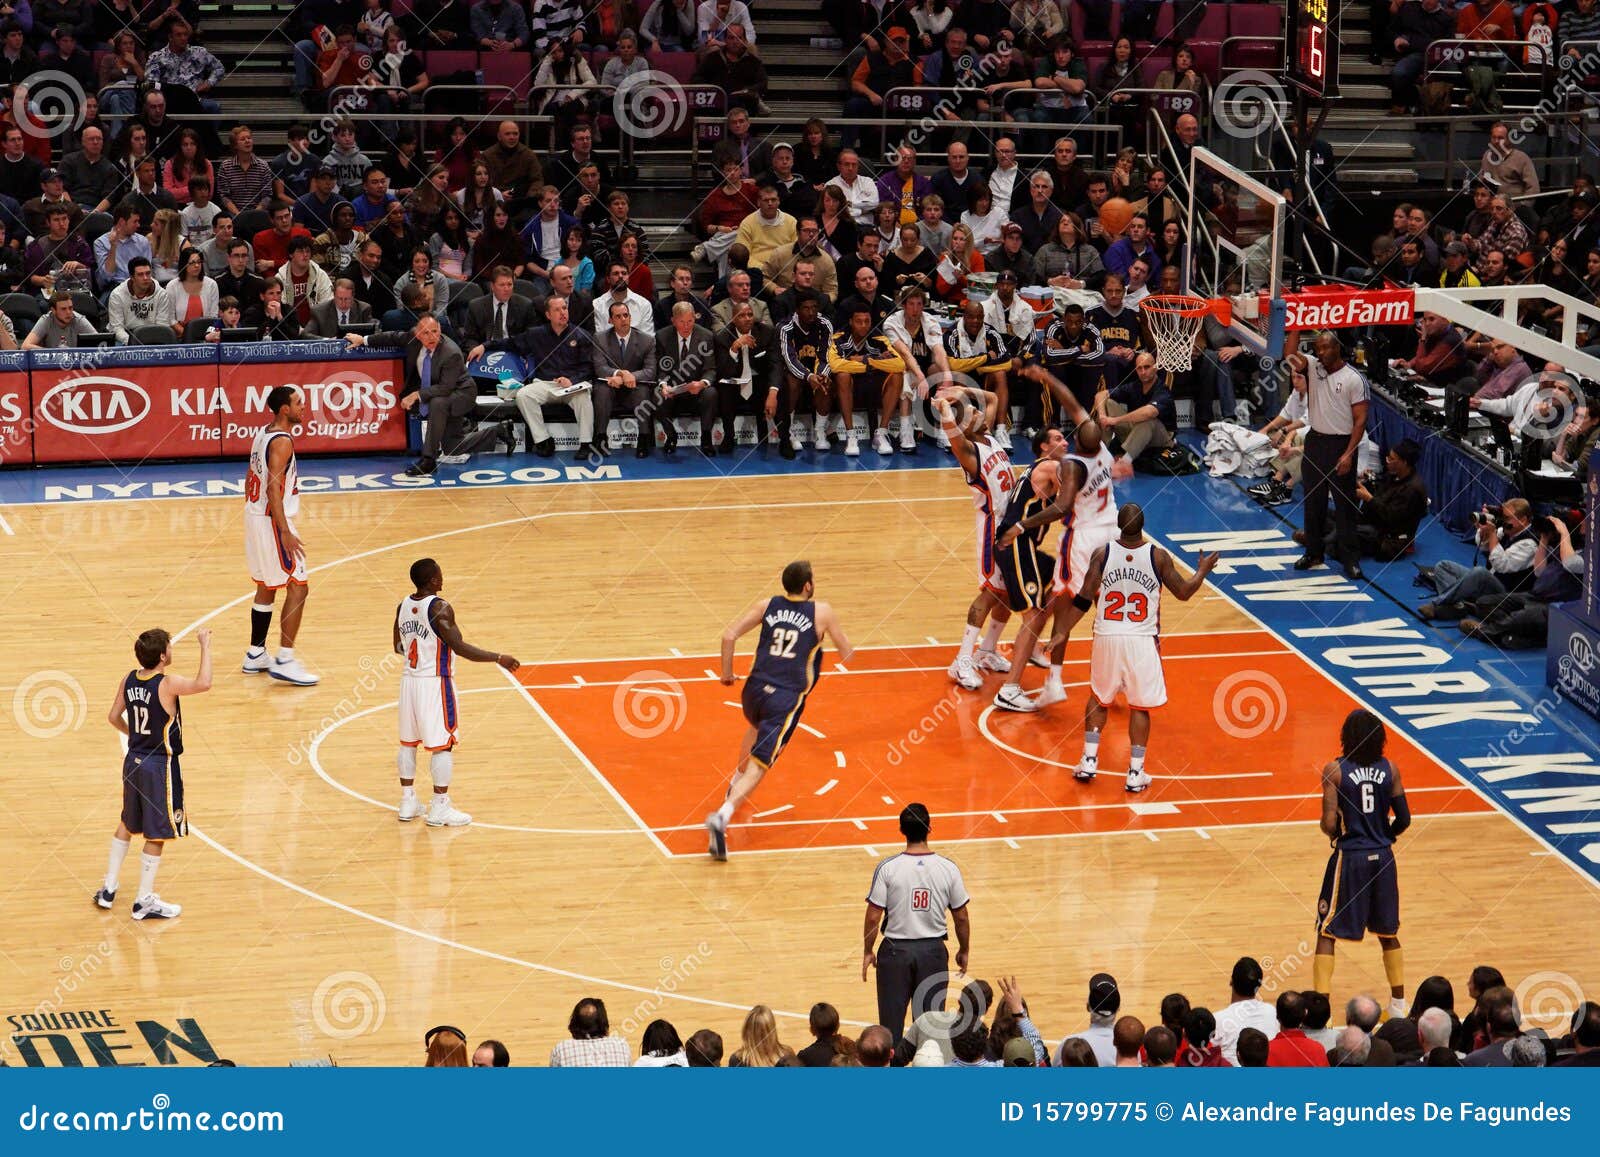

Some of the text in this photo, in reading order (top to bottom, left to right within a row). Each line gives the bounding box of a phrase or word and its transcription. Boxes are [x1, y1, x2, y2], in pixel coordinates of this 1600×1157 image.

[1311, 25, 1322, 77] 6
[1442, 47, 1465, 61] 90
[695, 92, 717, 106] 87
[900, 95, 923, 108] 88
[1171, 97, 1193, 110] 89
[61, 390, 134, 421] KIA
[171, 387, 233, 416] KIA
[189, 424, 220, 440] The
[45, 464, 622, 500] NYKNCKS.COM
[1097, 488, 1109, 512] 7
[1166, 528, 1375, 602] NEW
[1101, 567, 1159, 594] RICHARDSON
[1103, 590, 1149, 622] 23
[765, 609, 814, 633] McROBERTS
[407, 638, 419, 670] 4
[769, 627, 800, 659] 32
[1573, 637, 1593, 668] KIA
[1289, 617, 1542, 730] YORK
[132, 705, 152, 735] 12
[1348, 767, 1387, 785] DANIELS
[1361, 783, 1375, 814] 6
[913, 890, 929, 909] 58
[7, 1009, 121, 1032] SQUARE
